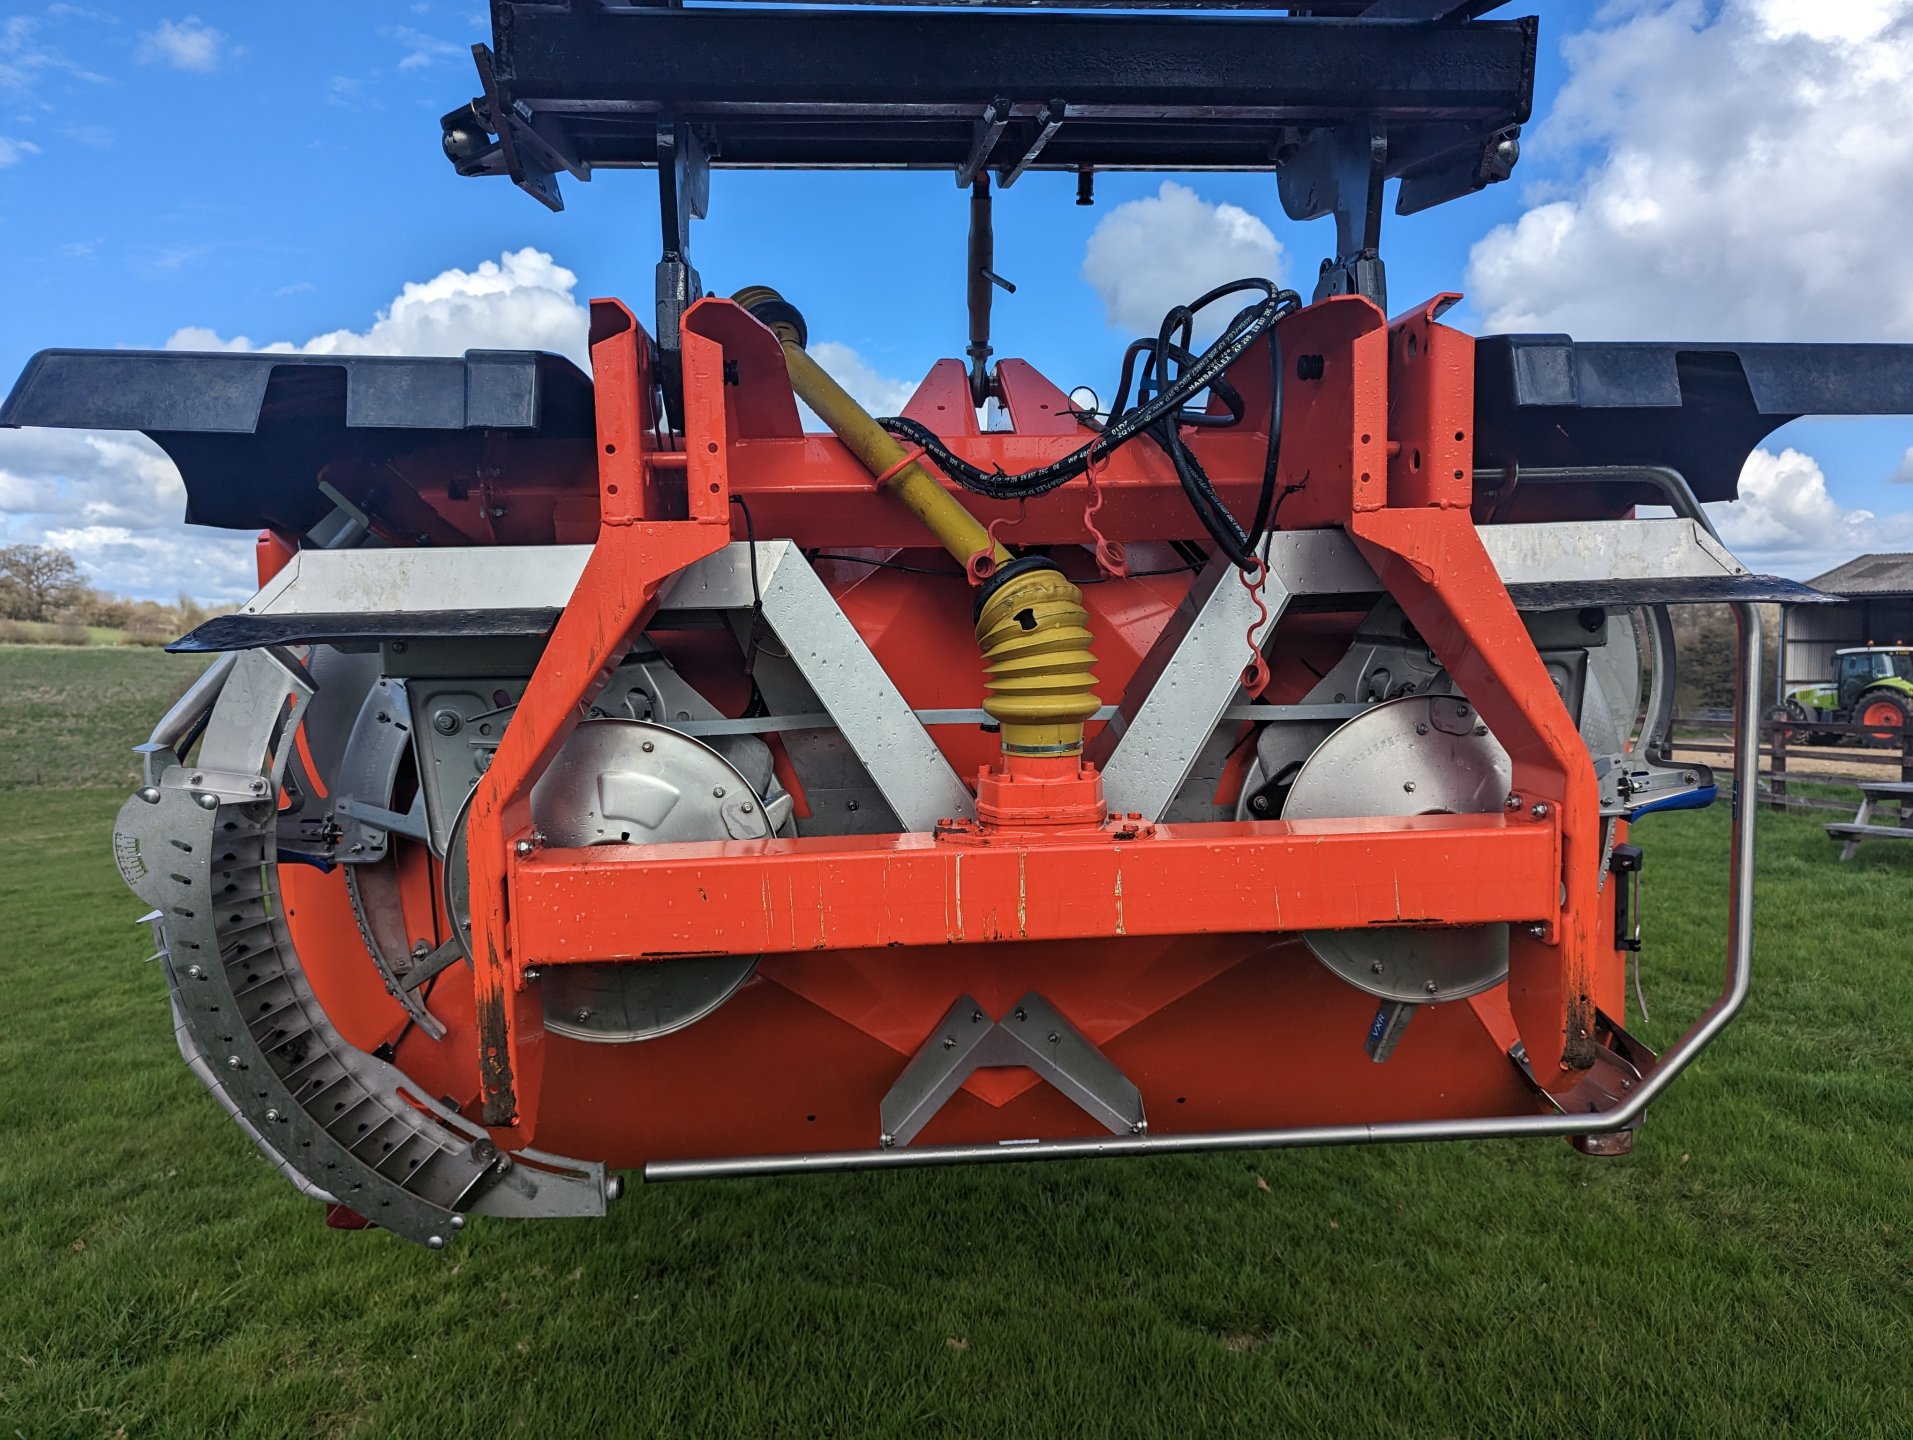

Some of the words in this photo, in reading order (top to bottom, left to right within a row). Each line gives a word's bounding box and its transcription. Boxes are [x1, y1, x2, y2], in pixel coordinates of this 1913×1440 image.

[1188, 354, 1232, 391] HANSA-FLEX
[1068, 456, 1078, 464] WP
[1372, 1013, 1385, 1036] VXR
